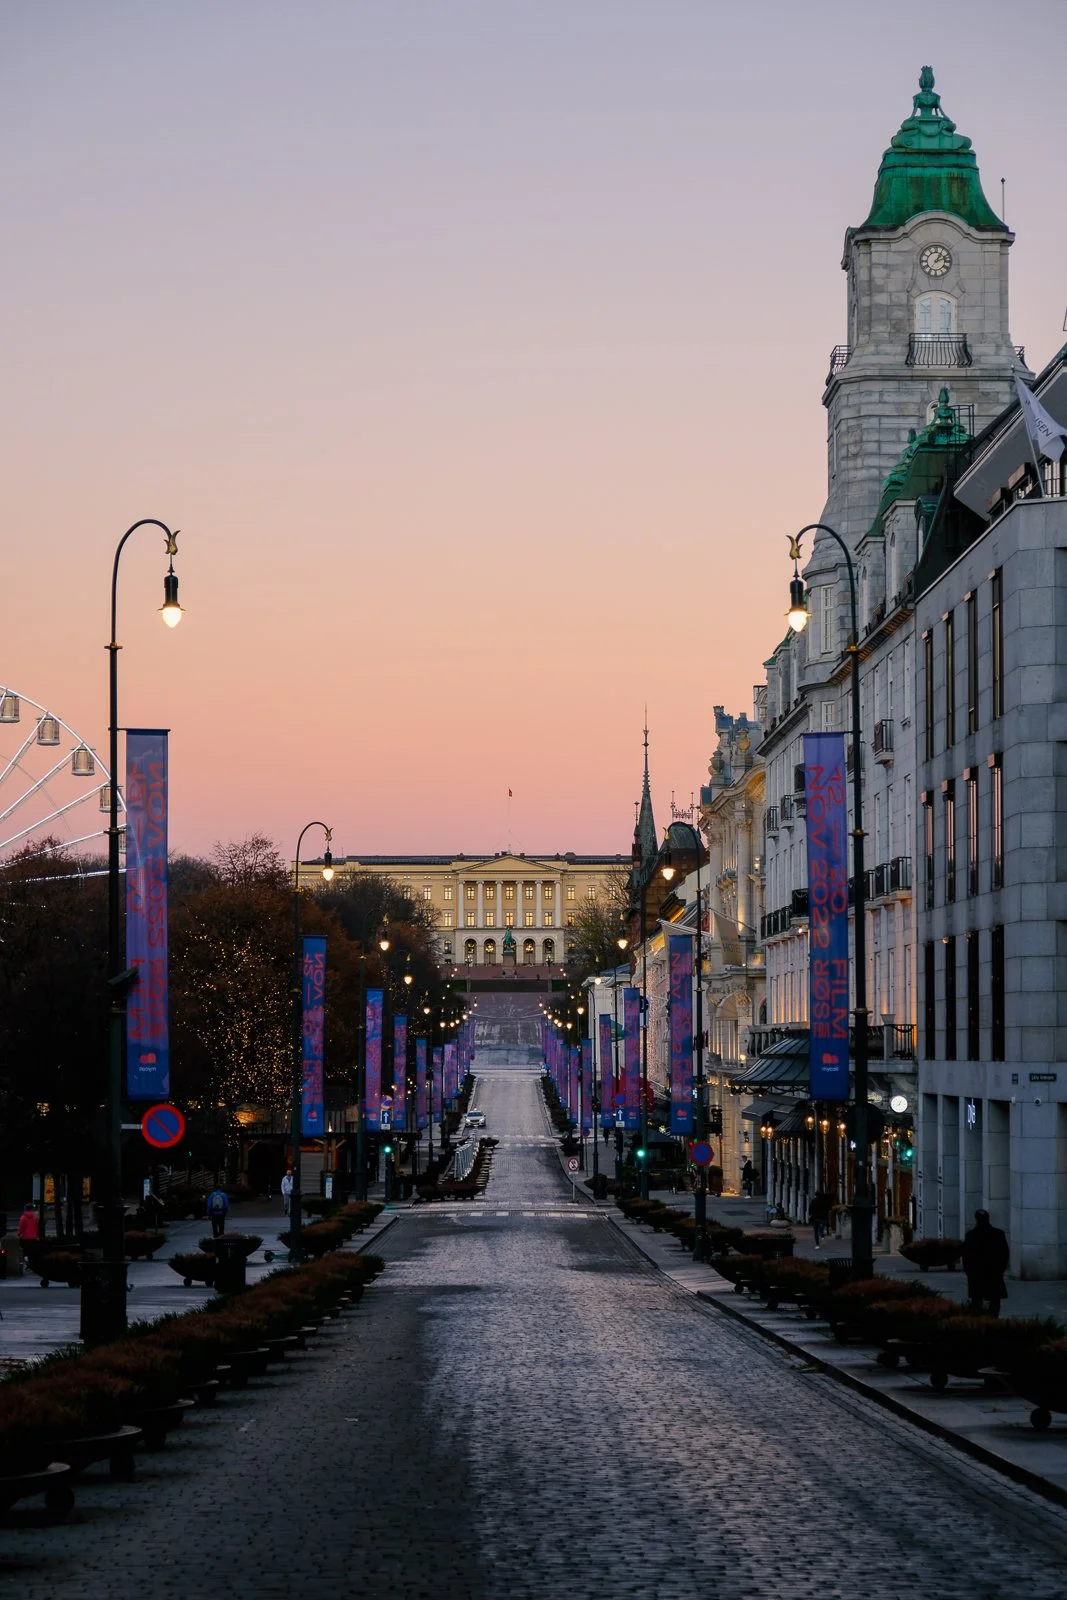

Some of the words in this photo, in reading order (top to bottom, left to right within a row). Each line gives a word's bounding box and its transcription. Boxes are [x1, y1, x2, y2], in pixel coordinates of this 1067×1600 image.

[808, 765, 827, 849] NOV
[810, 859, 829, 949] 2022
[671, 953, 681, 999] NOV
[831, 958, 848, 1039] FILM
